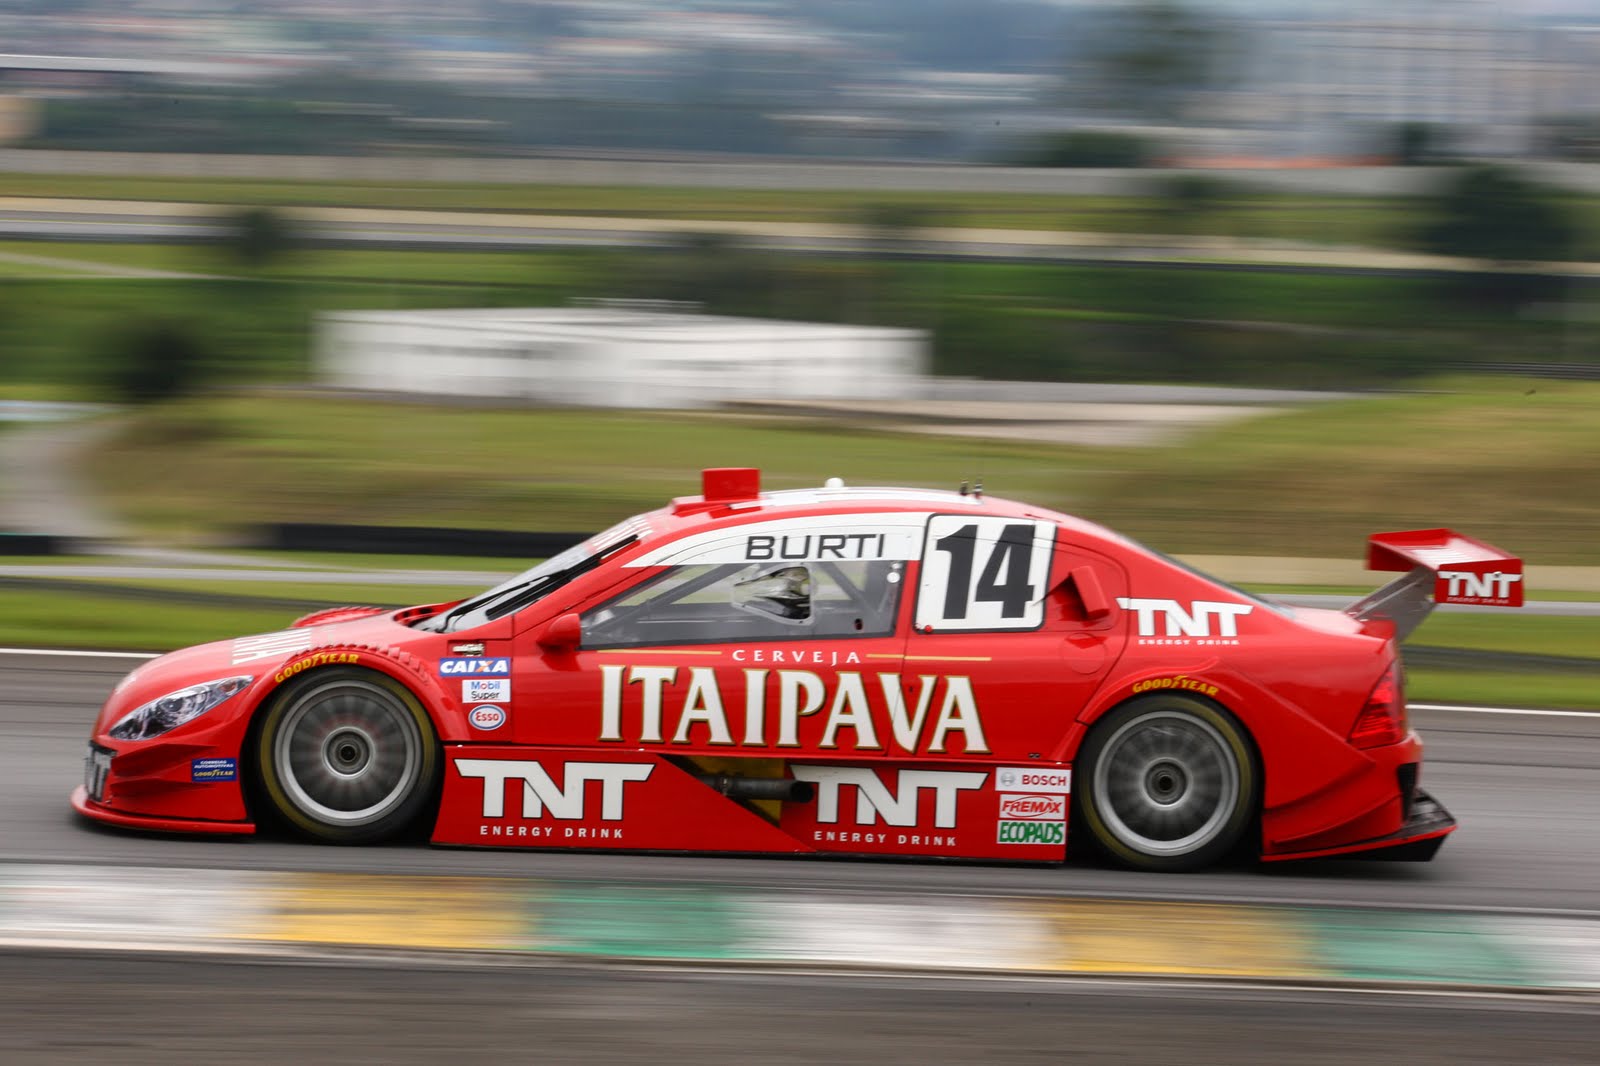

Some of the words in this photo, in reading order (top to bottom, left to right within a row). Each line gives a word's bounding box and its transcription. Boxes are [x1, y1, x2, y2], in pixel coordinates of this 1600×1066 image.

[745, 533, 887, 560] BURTI
[936, 524, 1036, 620] 14
[1436, 570, 1523, 599] TNT
[1115, 597, 1254, 637] TNT
[275, 652, 359, 684] GOODYEAR
[440, 660, 508, 674] CAIXA
[732, 649, 861, 666] CERVEJA
[471, 681, 501, 691] Mobil
[471, 691, 500, 701] Super
[1132, 675, 1219, 697] GOODYEAR
[475, 711, 500, 722] Esso
[597, 664, 992, 756] ITAIPAVA
[454, 758, 655, 821] TNT
[1022, 774, 1067, 787] BOSCH
[788, 764, 990, 829] TNT
[1001, 800, 1062, 814] FREMAX
[480, 825, 553, 837] ENERGY
[564, 827, 623, 839] DRINK
[813, 830, 887, 844] ENERGY
[898, 834, 957, 846] DRINK
[998, 821, 1065, 844] ECOPADS
